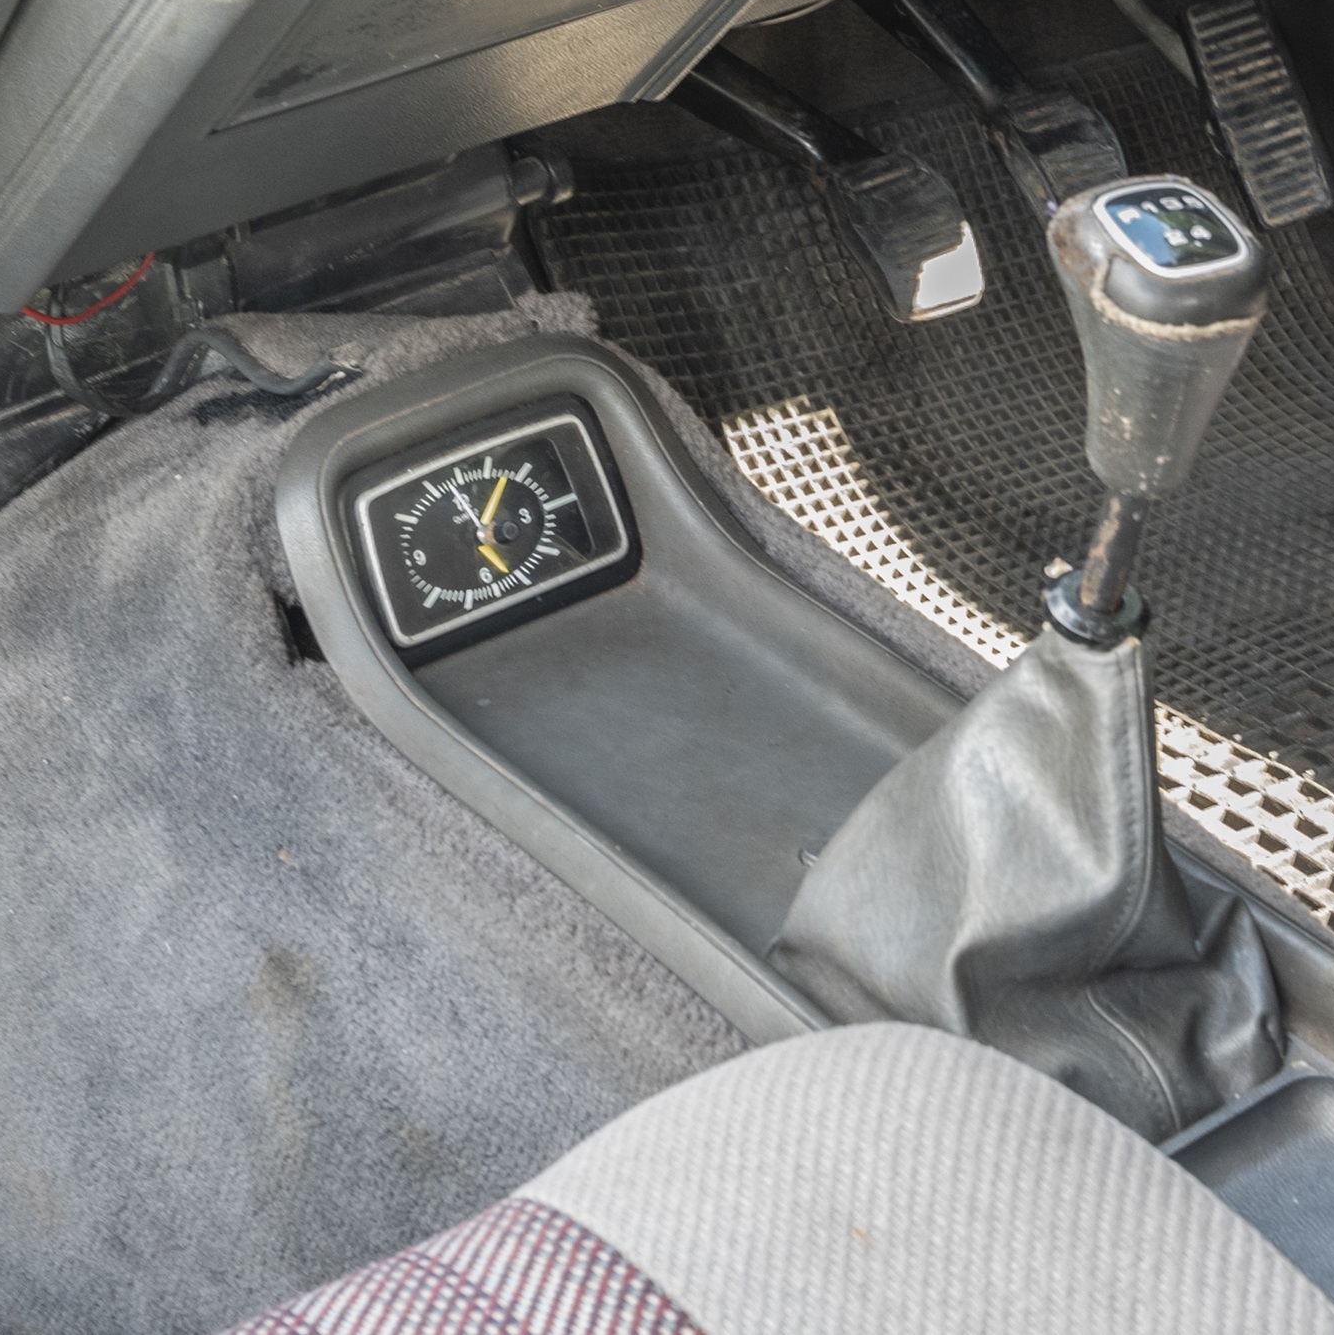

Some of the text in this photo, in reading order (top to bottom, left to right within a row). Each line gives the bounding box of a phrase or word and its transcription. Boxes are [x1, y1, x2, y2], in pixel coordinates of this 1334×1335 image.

[518, 507, 532, 524] 3
[413, 549, 427, 565] 9
[479, 567, 493, 584] 6
